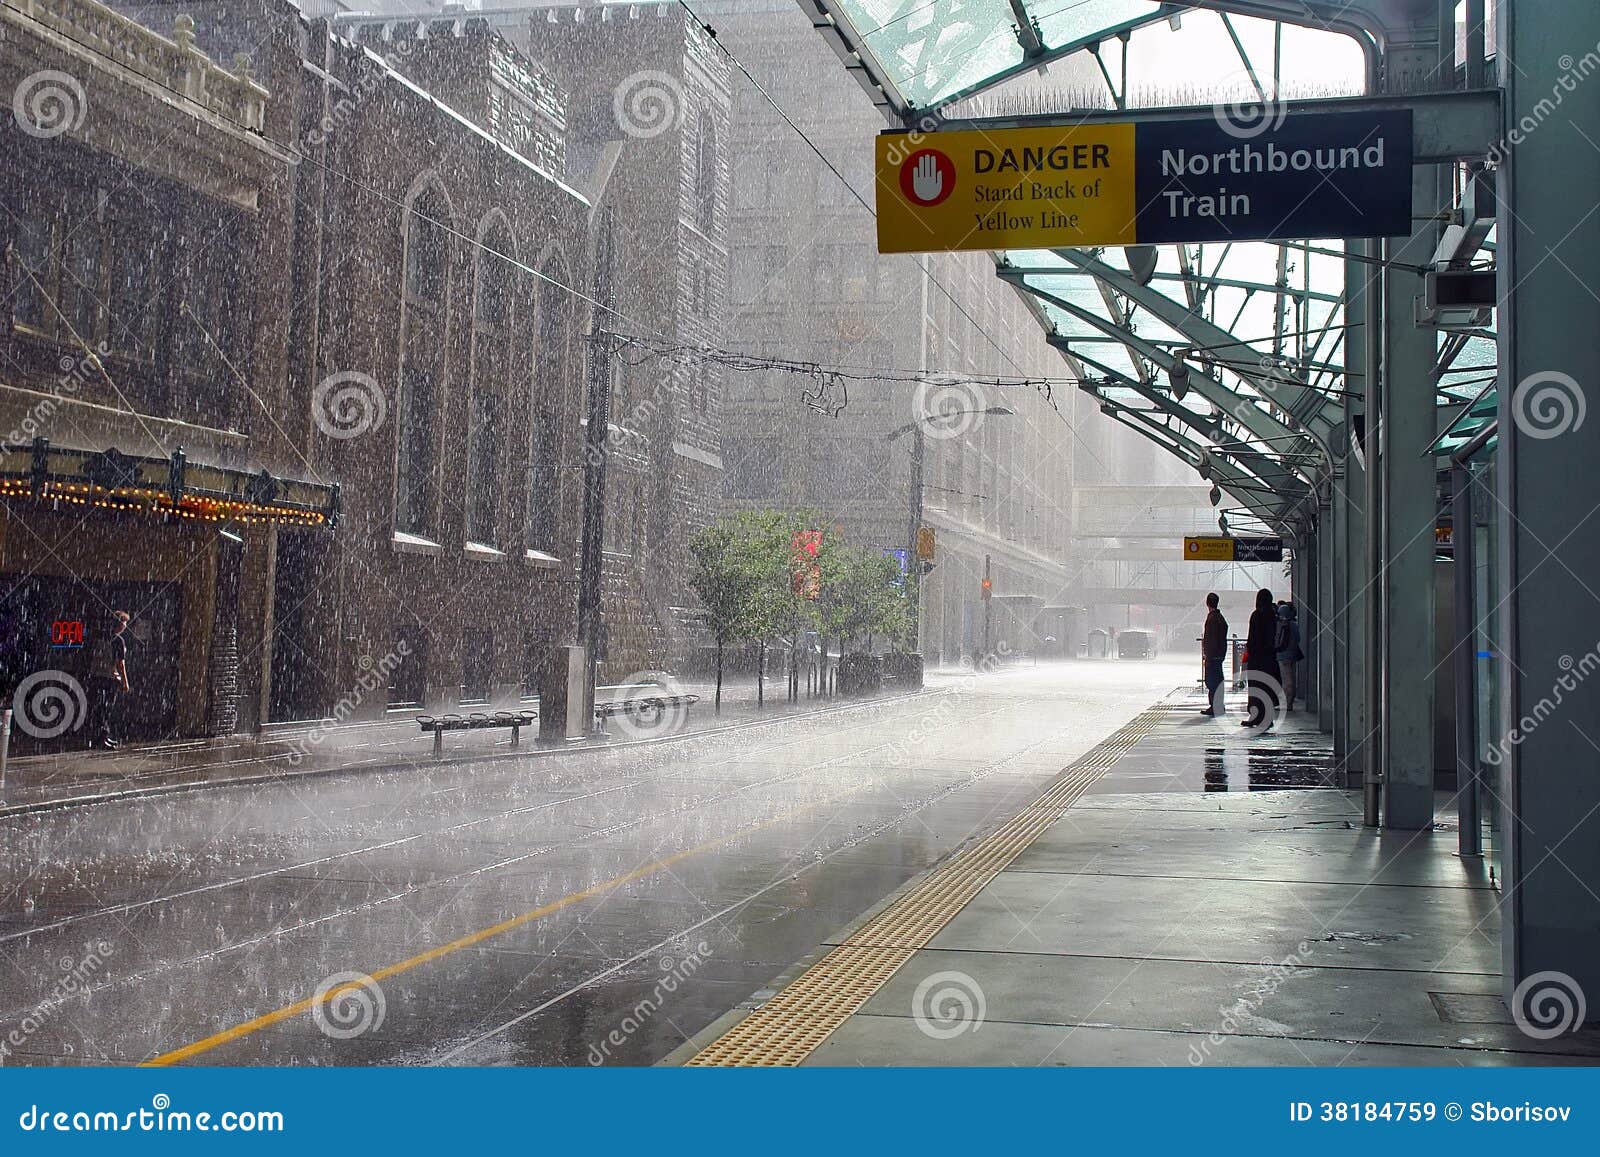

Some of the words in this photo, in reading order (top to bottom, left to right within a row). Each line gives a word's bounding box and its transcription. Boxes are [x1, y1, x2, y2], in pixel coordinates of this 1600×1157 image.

[973, 144, 1110, 174] DANGER
[1161, 137, 1385, 176] Northbound
[974, 183, 1024, 202] Stand
[1031, 180, 1075, 200] Back
[1082, 178, 1102, 197] of
[1162, 188, 1250, 218] Train
[974, 212, 1034, 231] Yellow
[1040, 212, 1079, 229] Line
[52, 620, 83, 643] OPEN
